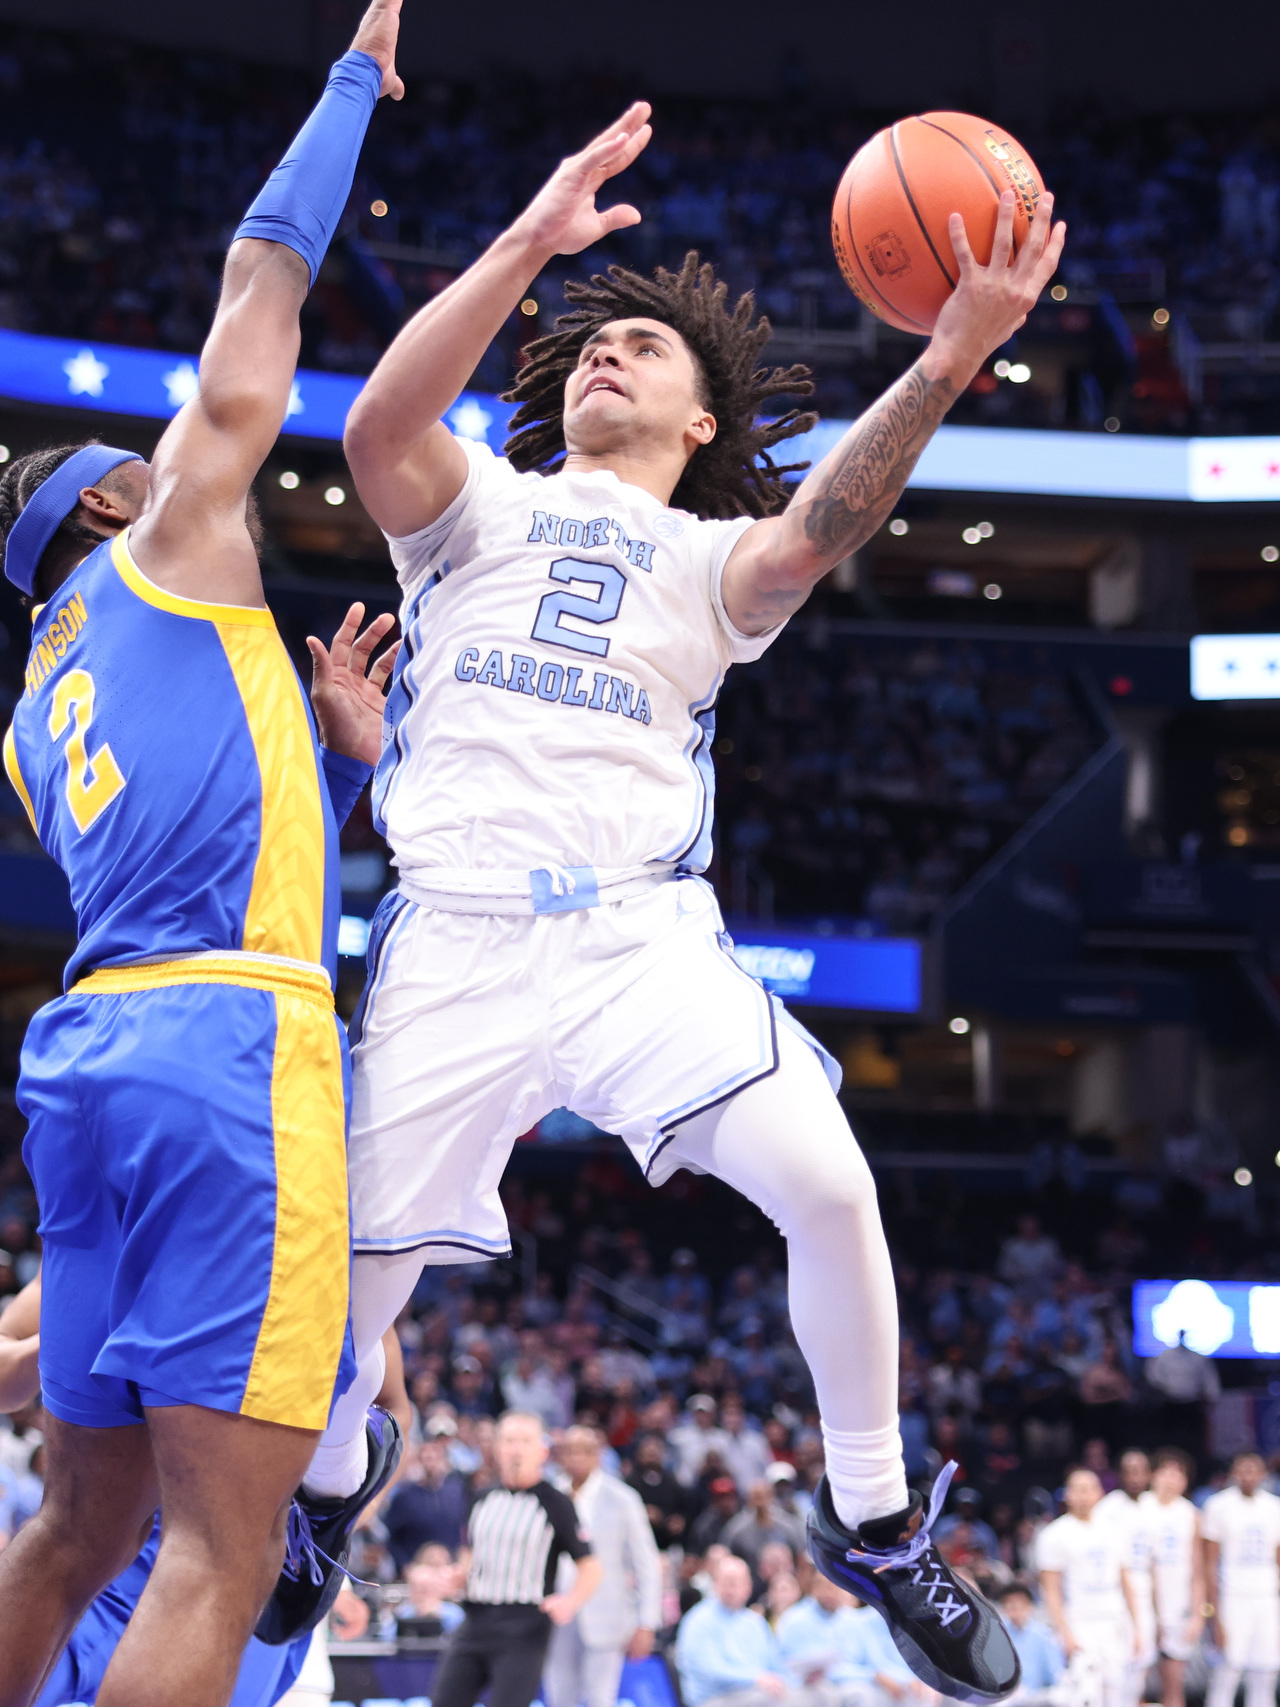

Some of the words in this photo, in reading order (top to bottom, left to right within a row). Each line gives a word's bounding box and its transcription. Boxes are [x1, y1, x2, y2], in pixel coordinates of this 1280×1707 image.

[527, 510, 655, 573] NORTH
[24, 591, 89, 699] HINSON
[530, 556, 627, 658] 2
[455, 647, 652, 725] CAROLINA
[48, 668, 127, 836] 2
